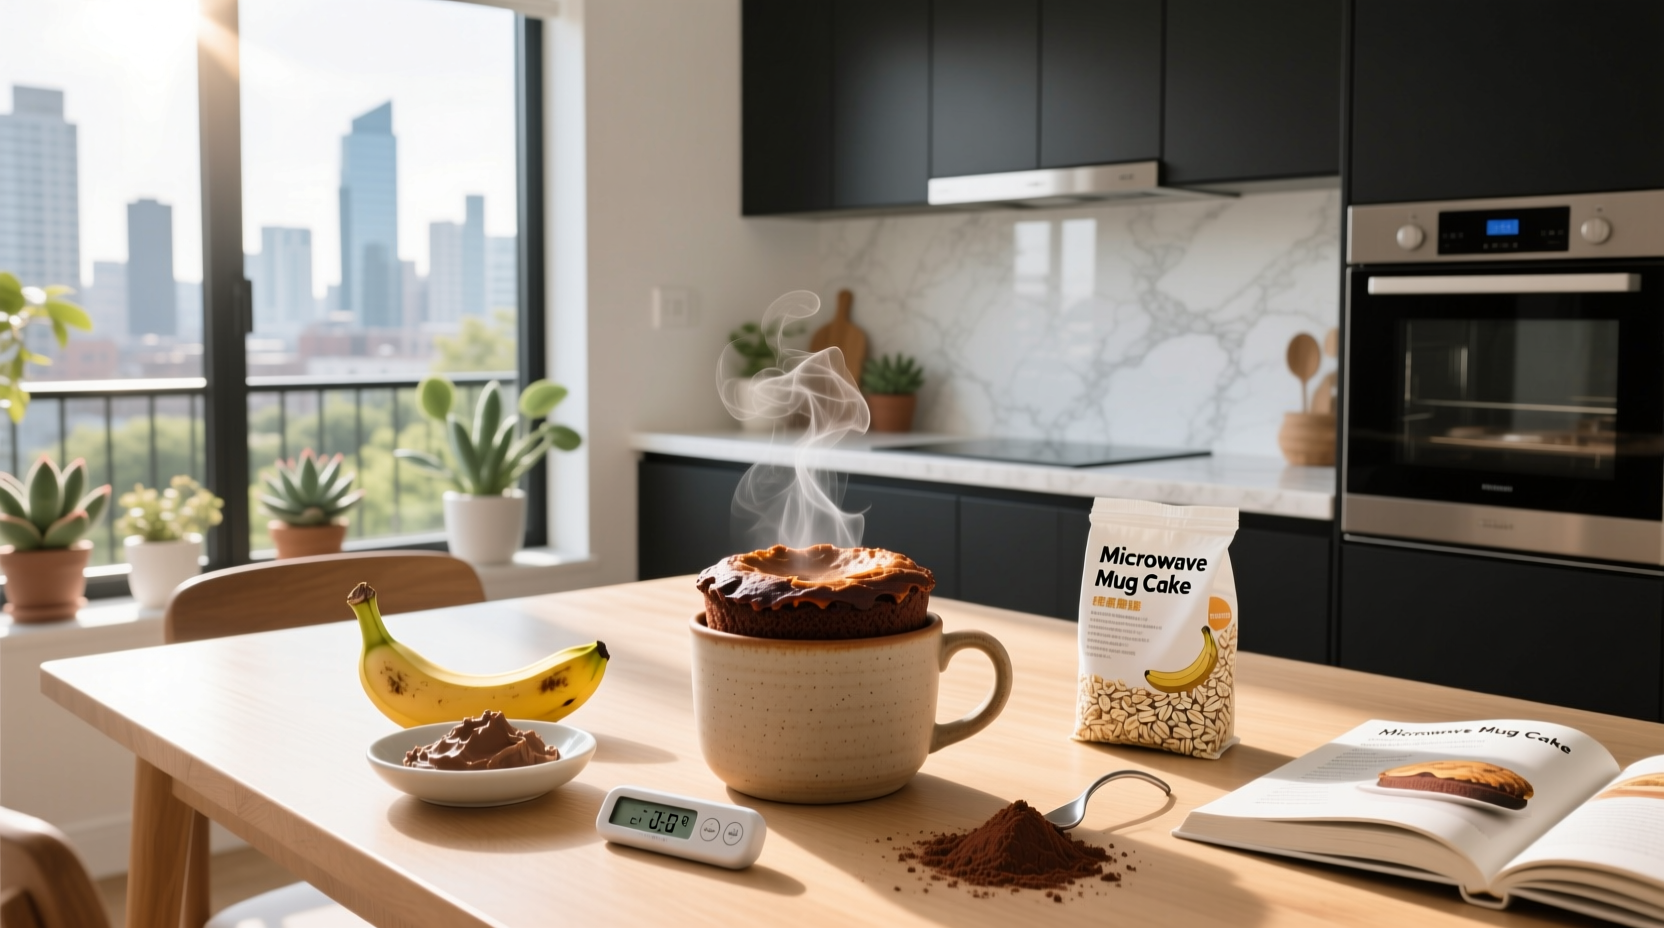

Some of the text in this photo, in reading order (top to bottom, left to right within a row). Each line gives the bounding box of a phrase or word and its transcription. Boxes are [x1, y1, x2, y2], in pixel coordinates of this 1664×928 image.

[1099, 545, 1208, 572] Microwave
[1094, 569, 1192, 596] Mug Cake
[1478, 726, 1520, 738] Mug
[1524, 731, 1572, 755] Cake
